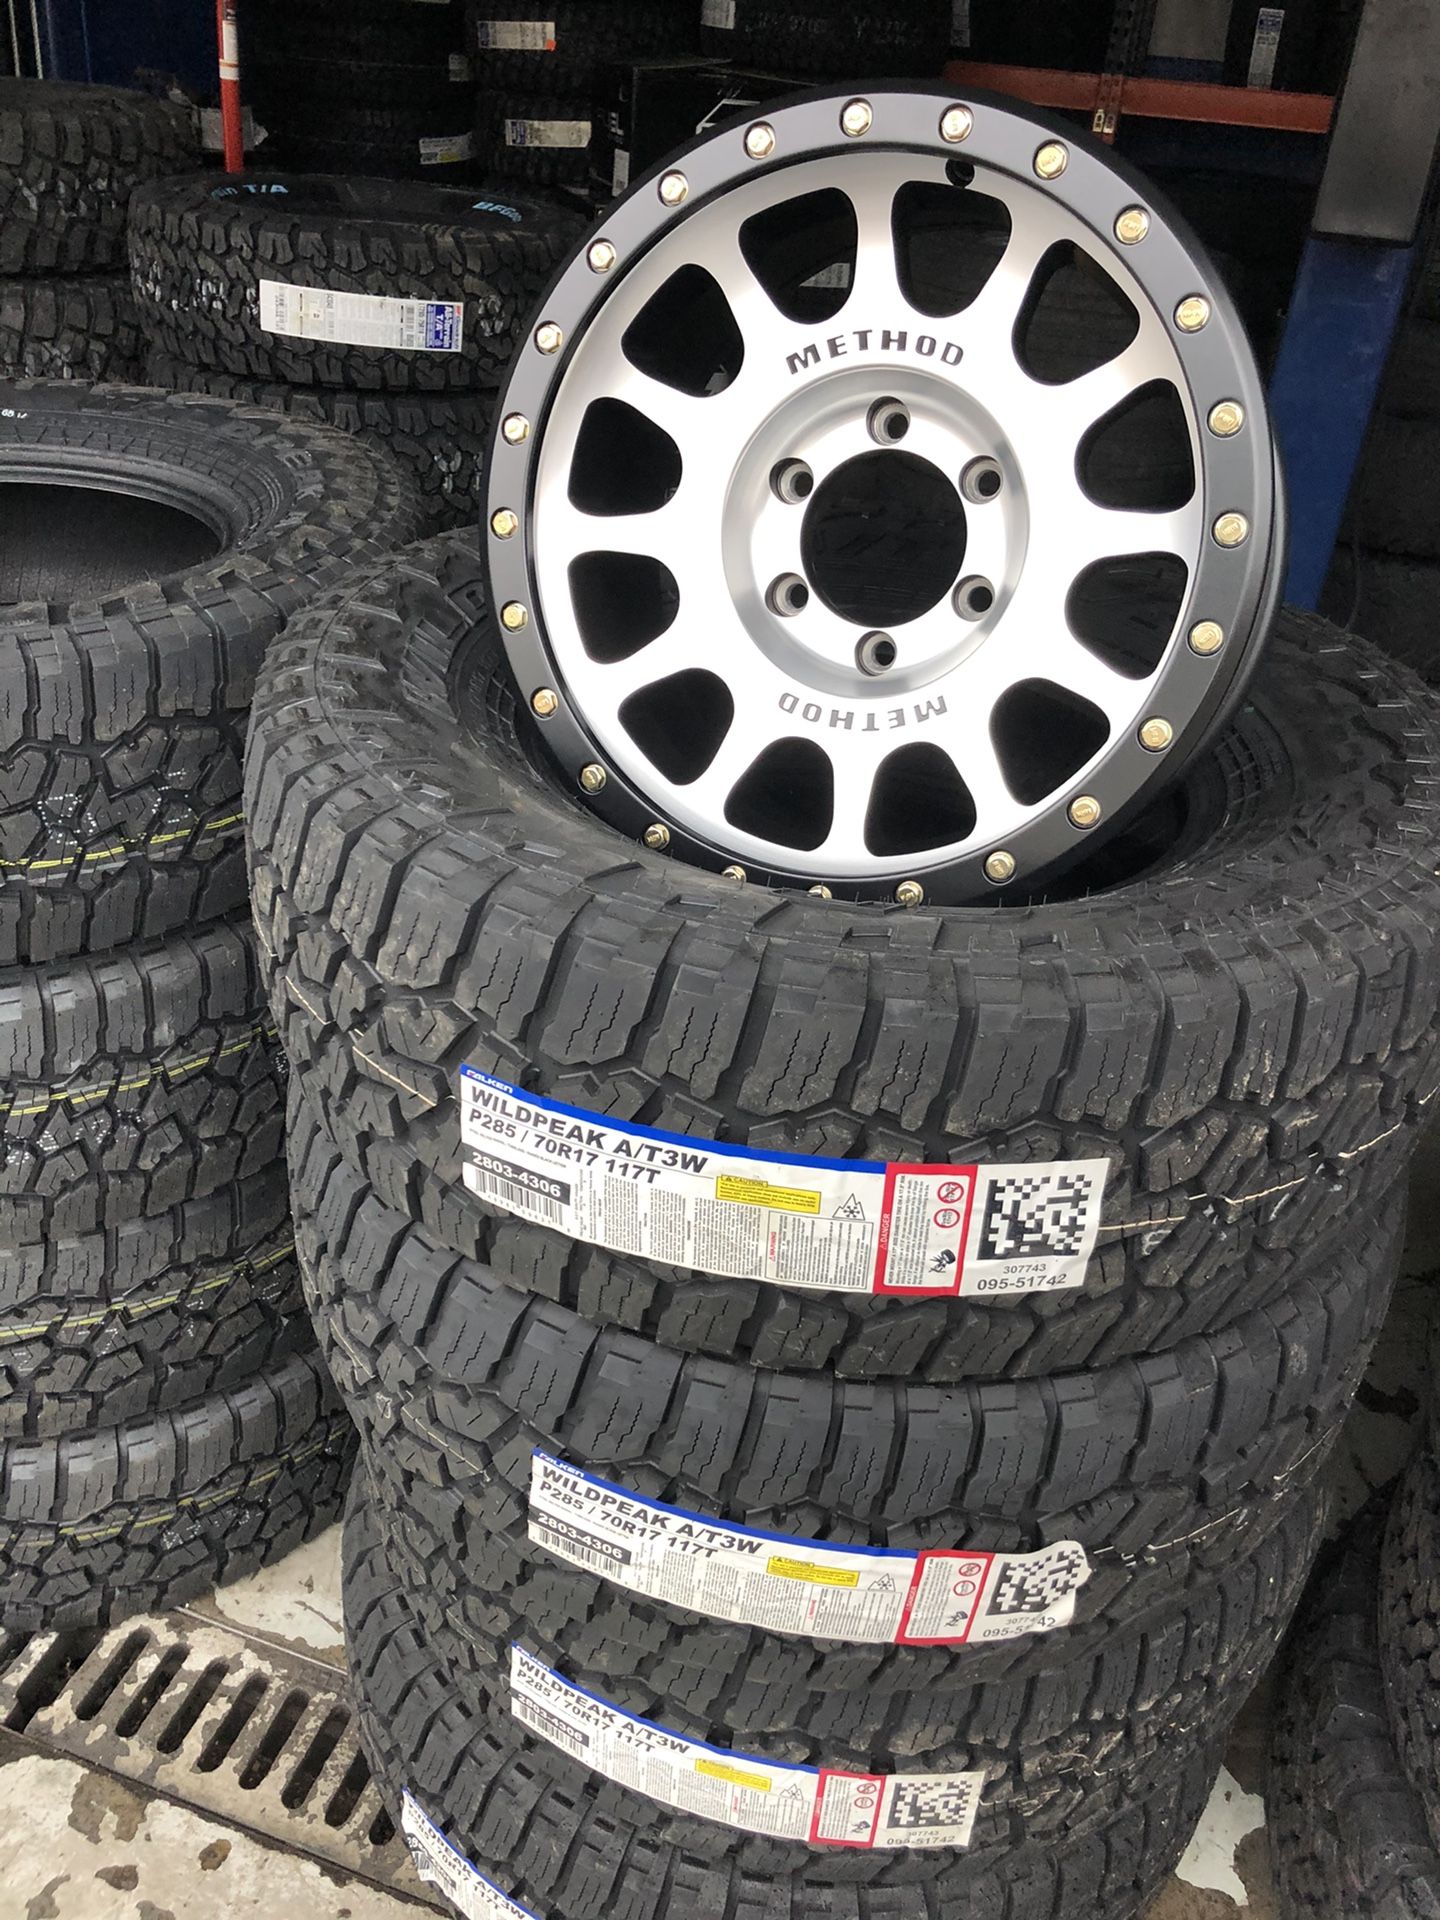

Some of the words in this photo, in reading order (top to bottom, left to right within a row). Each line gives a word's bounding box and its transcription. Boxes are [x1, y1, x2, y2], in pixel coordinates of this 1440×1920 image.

[785, 329, 964, 375] METHOD
[778, 692, 948, 732] METHOD
[466, 1069, 513, 1094] FALKEN
[469, 1108, 517, 1138] P285
[534, 1133, 599, 1166] 70R17
[605, 1158, 661, 1184] 117T
[472, 1085, 608, 1150] WILDPEAK
[612, 1138, 709, 1174] A/T3W
[472, 1151, 561, 1198] 2803-4306
[880, 1213, 891, 1243] DANGER
[977, 1273, 1067, 1291] 095-51742
[1003, 1263, 1047, 1274] 307743
[540, 1480, 584, 1510] P285
[600, 1510, 661, 1540] 70R17
[668, 1536, 718, 1558] 117T
[543, 1465, 671, 1529] WILDPEAK
[675, 1523, 764, 1554] A/T3W
[538, 1512, 623, 1559] 2803-4306
[516, 1693, 583, 1742] 2803-4306
[517, 1669, 552, 1697] P285
[564, 1700, 611, 1730] 70R17
[615, 1730, 655, 1752] 117T
[519, 1656, 617, 1724] WILDPEAK
[621, 1721, 690, 1754] A/T3W
